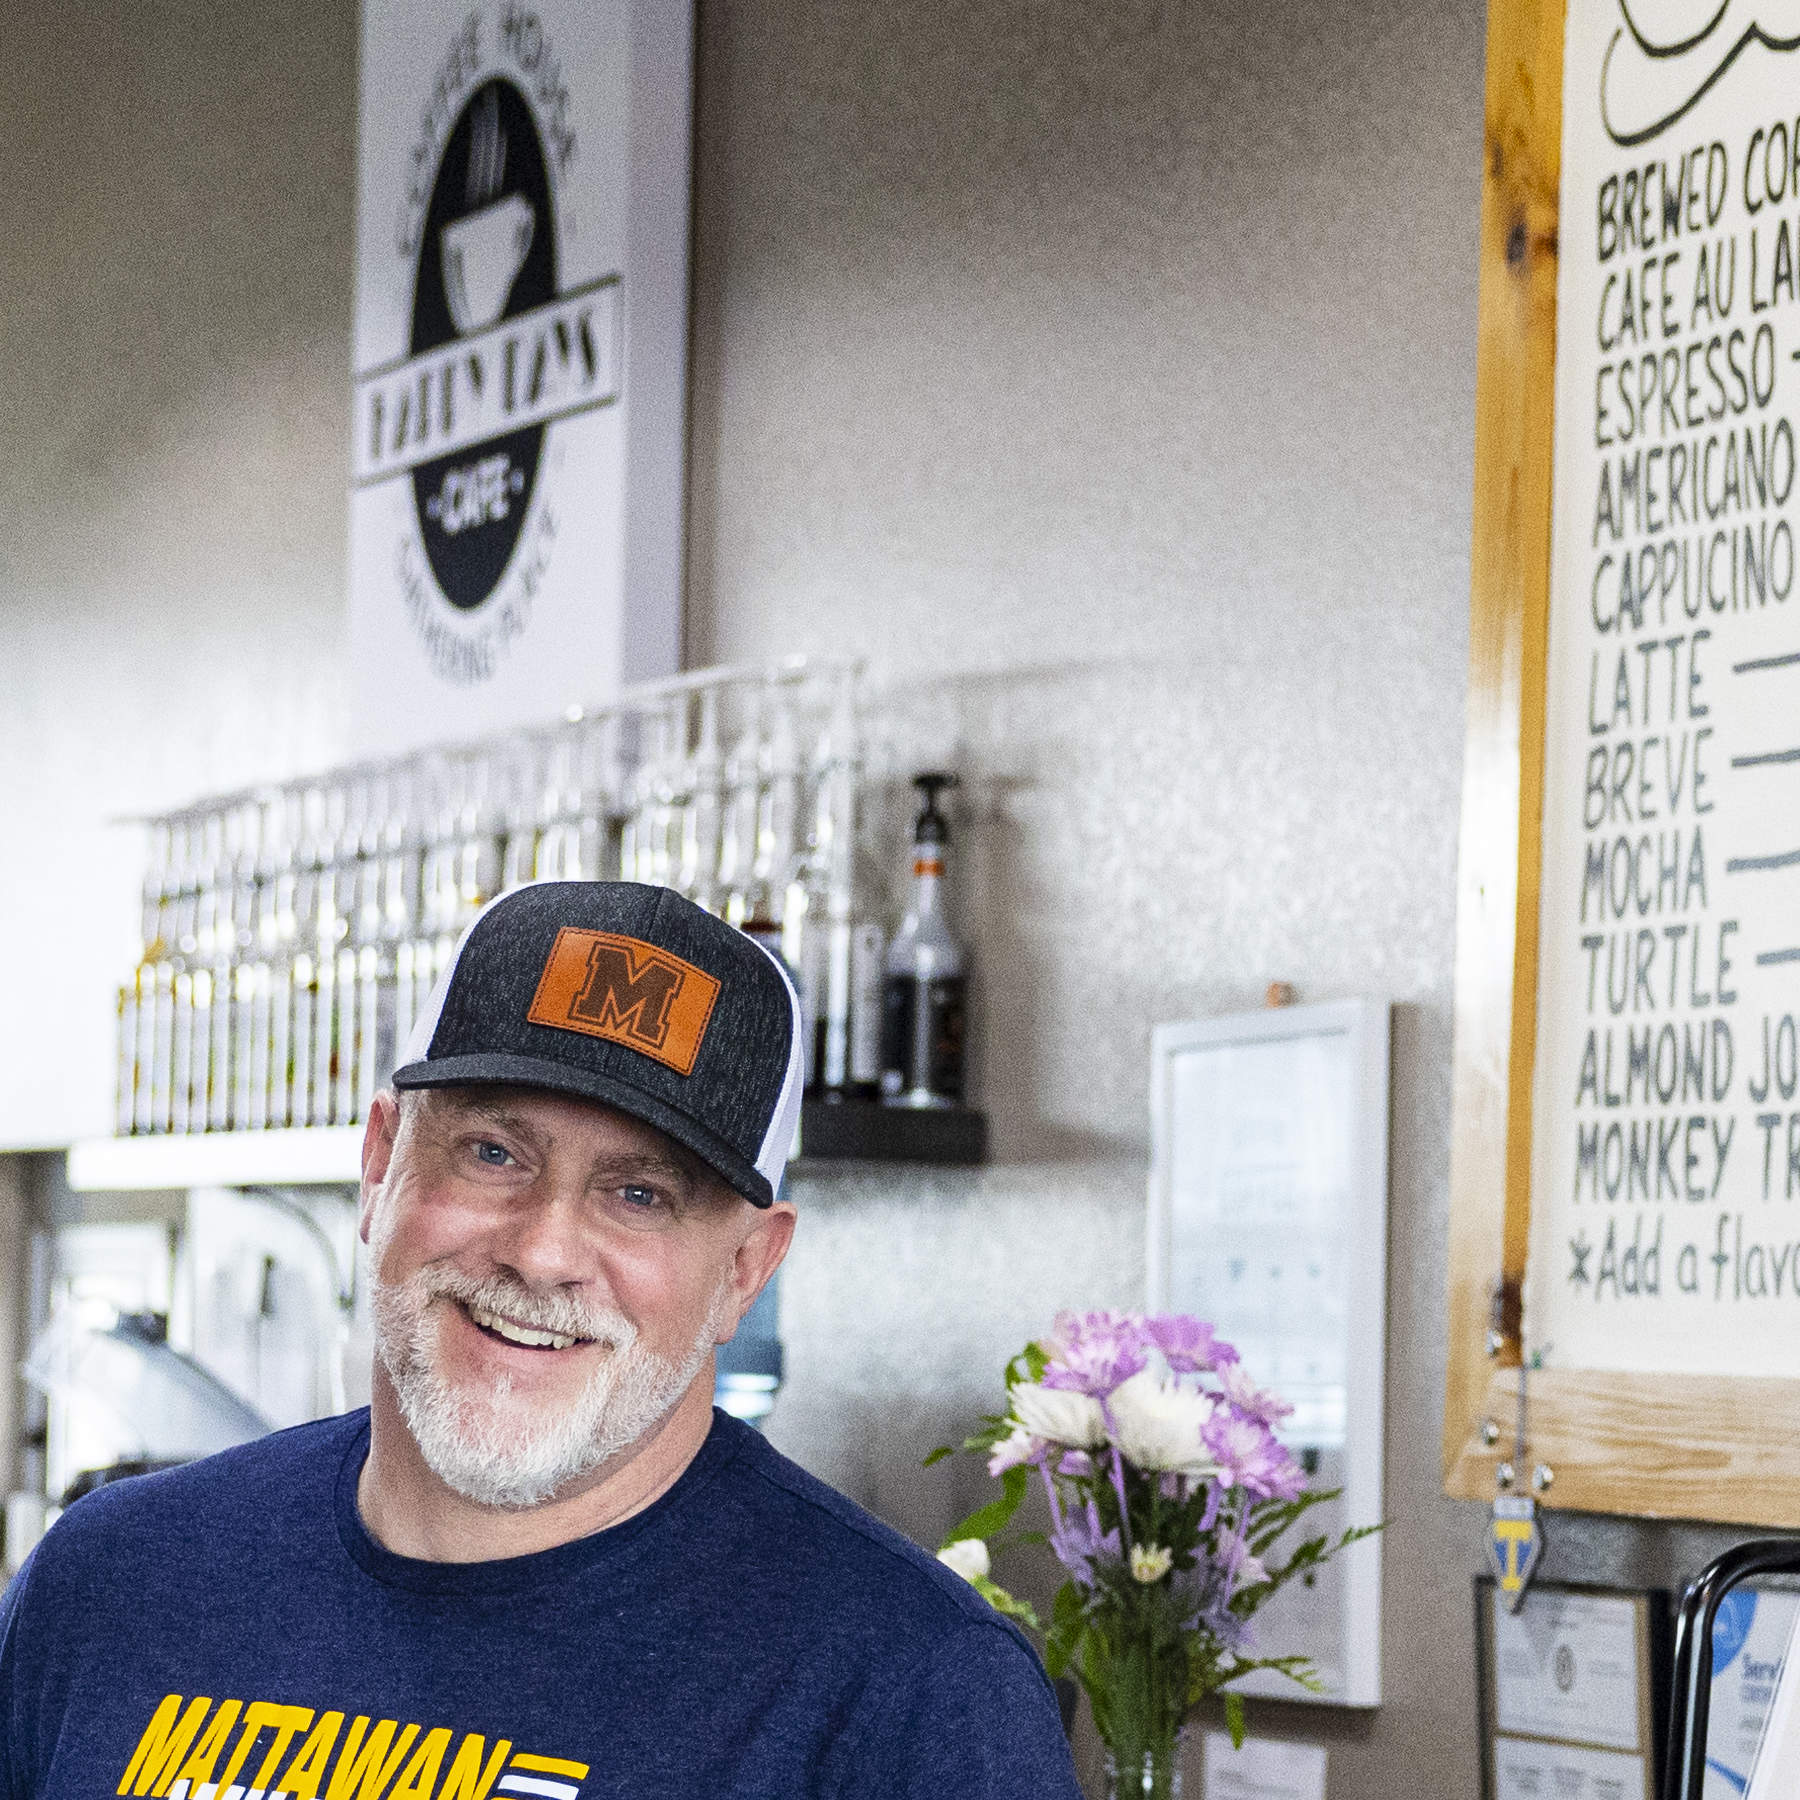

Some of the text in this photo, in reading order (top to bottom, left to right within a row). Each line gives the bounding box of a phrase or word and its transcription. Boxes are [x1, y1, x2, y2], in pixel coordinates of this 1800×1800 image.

[1599, 141, 1727, 262] BREWED
[1598, 252, 1680, 352] CAFE
[1691, 231, 1742, 319] AU
[1596, 323, 1775, 458] ESPRESSO
[1594, 415, 1796, 545] AMERICANO
[1592, 519, 1794, 634] CAPPUCINO
[1589, 629, 1711, 736] LATTE
[1584, 727, 1714, 830] BREVE
[1581, 826, 1706, 921] MOCHA
[568, 941, 686, 1050] M
[1581, 920, 1738, 1014] TURTLE
[1577, 1019, 1733, 1107] ALMOND
[1576, 1116, 1734, 1201] MONKEY
[1678, 1241, 1701, 1291] a
